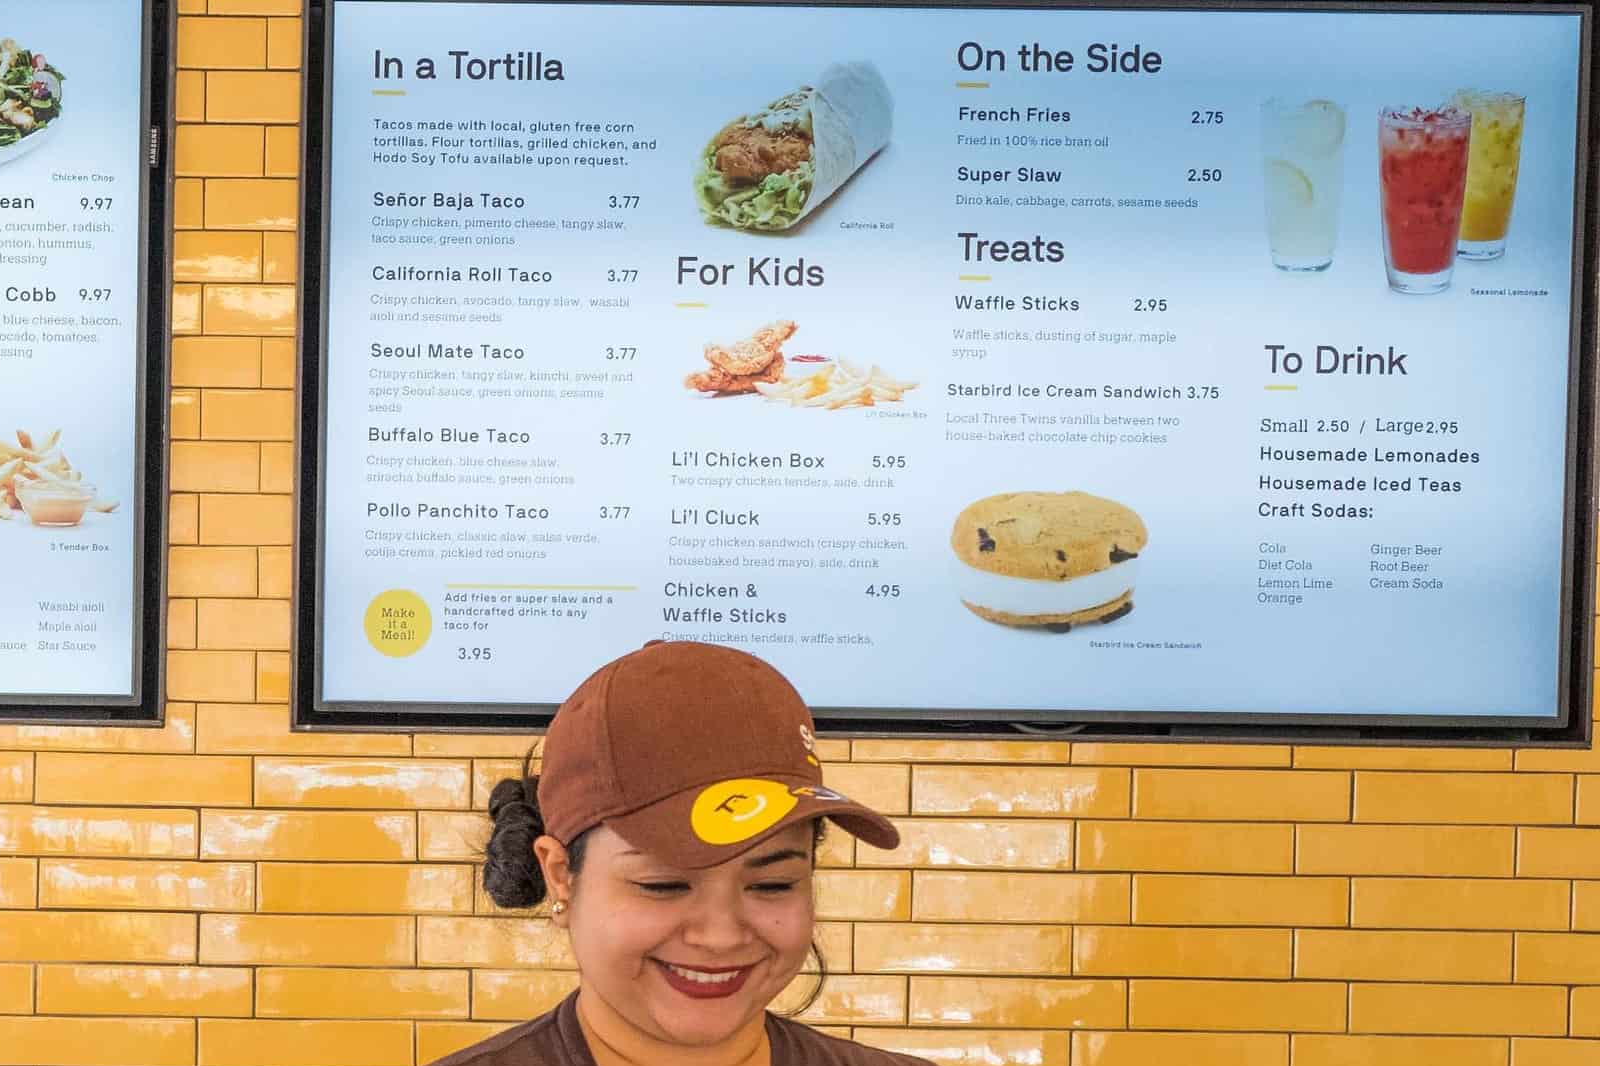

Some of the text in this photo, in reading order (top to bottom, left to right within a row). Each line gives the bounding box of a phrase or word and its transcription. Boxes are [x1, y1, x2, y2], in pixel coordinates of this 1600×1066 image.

[374, 50, 565, 81] In a Tortilla
[958, 42, 1162, 74] On the Side
[959, 106, 1224, 124] French Fries 2.75
[958, 166, 1222, 184] Super Slaw 2.50
[80, 198, 112, 210] 9.97
[374, 192, 640, 211] Señor Baja Taco 3.77
[957, 232, 1064, 263] Treats
[372, 266, 638, 282] California Roll Taco 3.77
[678, 256, 824, 287] For Kids
[6, 286, 56, 302] Cobb
[79, 288, 111, 301] 9.97
[955, 295, 1167, 312] Waffle Sticks 2.95
[371, 343, 636, 360] Seoul Mate Taco 3.77
[1264, 344, 1408, 375] To Drink
[948, 383, 1219, 399] Starbird Ice Cream Sandwich 3.75
[1260, 418, 1458, 436] Small 2.50 / Large 2.95
[368, 427, 631, 445] Buffalo Blue Taco 3.77
[672, 451, 906, 468] Li'l Chicken Box 5.95
[1260, 446, 1480, 464] Housemade Lemonades
[1258, 502, 1373, 518] Craft Sodas:
[1370, 544, 1442, 558] Ginger Beer
[1258, 559, 1312, 570] Diet Cola
[664, 582, 900, 598] Chicken & 4.95
[663, 608, 786, 624] Waffle Sticks
